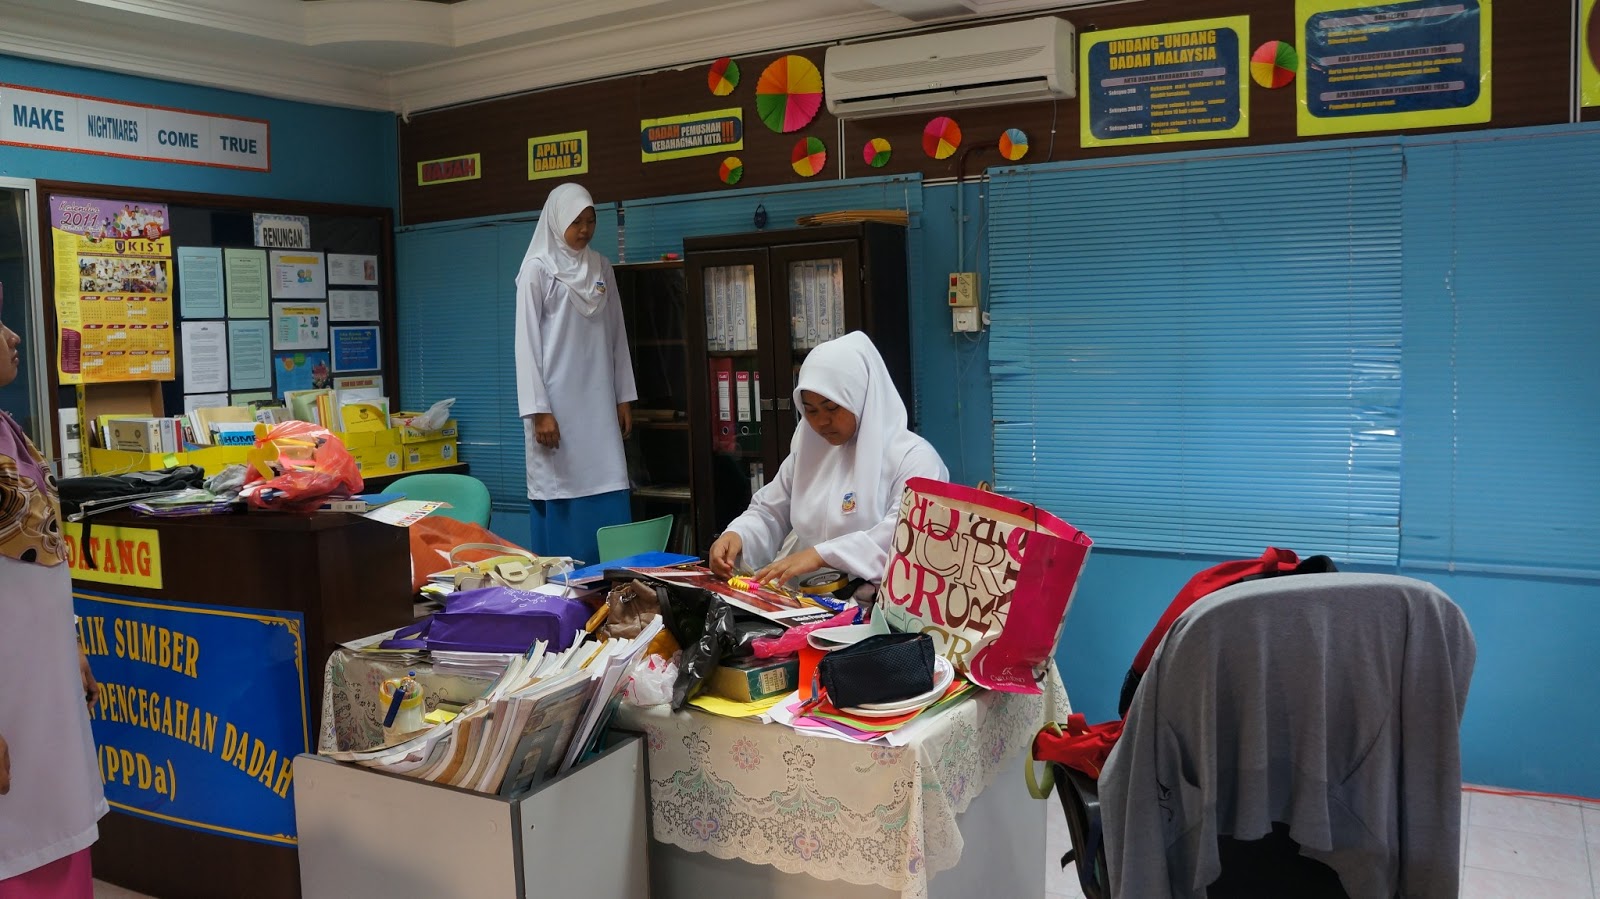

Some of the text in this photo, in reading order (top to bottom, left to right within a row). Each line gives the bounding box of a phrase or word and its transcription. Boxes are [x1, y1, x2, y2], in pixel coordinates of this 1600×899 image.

[1108, 29, 1217, 55] UNDANG-UNDANG
[1109, 46, 1217, 71] DADAH MALAYSIA
[13, 104, 257, 154] MAKE NIGHTMARES COME TRUE
[648, 125, 680, 141] DADAH
[681, 121, 721, 137] PEMUSNAH
[536, 140, 578, 157] APA ITU
[651, 133, 722, 152] KEBAHAGIAAN KITA
[534, 155, 571, 172] DADAH
[60, 212, 98, 227] 2011
[128, 241, 164, 253] KIST
[263, 227, 303, 248] RENUNGAN
[888, 553, 947, 626] CR
[77, 616, 199, 679] LIK SUMBER
[97, 682, 294, 799] PENCEGAHAN DADAH
[98, 744, 177, 802] (PPDa)
